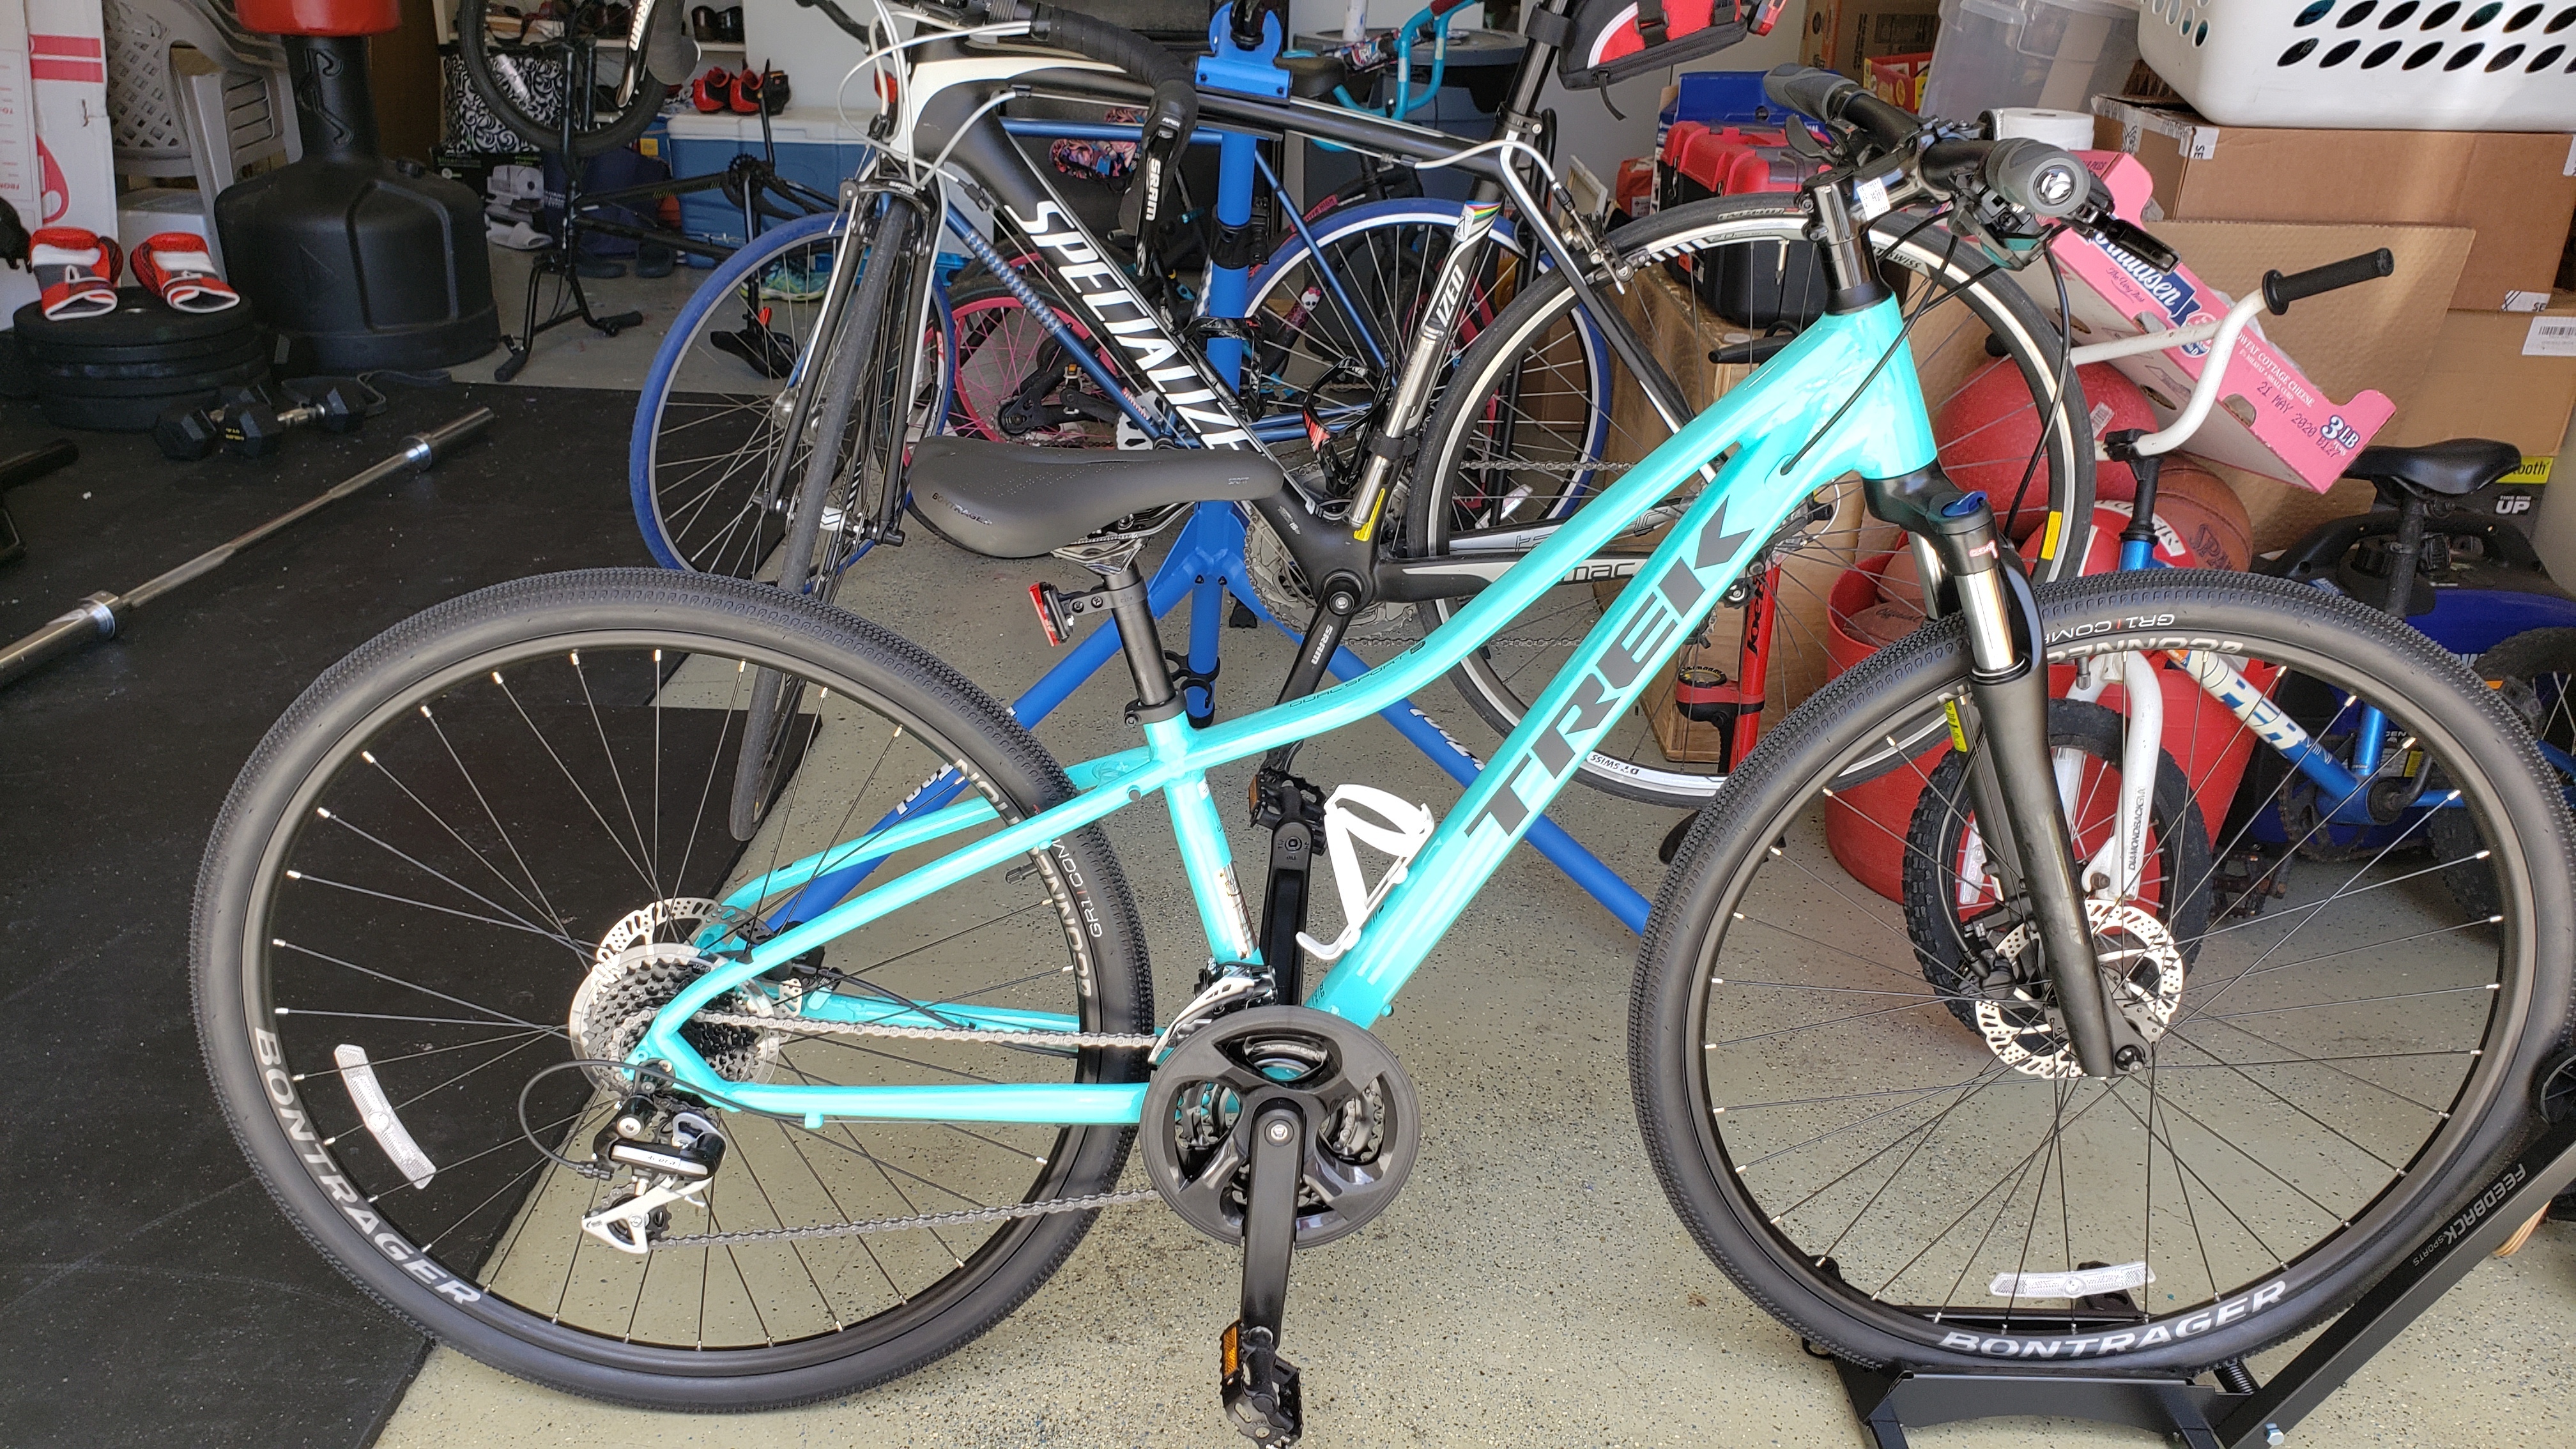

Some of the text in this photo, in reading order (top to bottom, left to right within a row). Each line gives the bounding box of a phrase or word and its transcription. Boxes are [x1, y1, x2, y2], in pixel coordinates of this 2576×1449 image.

[1146, 157, 1162, 221] SRAM
[1004, 200, 1264, 455] SPECIALIZE
[2258, 351, 2290, 384] COTTAGE
[2288, 380, 2315, 408] CHEESE
[2271, 394, 2294, 414] MAY
[2290, 413, 2318, 438] 2020
[2496, 500, 2531, 514] UP
[1310, 624, 1333, 665] SRAM
[2125, 613, 2175, 629] GR1
[1465, 495, 1754, 838] TREK
[1590, 754, 1620, 770] SWISS
[1081, 896, 1103, 938] GR1
[254, 1025, 482, 1306] BONTRAGER
[2412, 1163, 2526, 1267] FEEDBACK SPORTS
[1938, 1279, 2288, 1360] BONTRAGER
